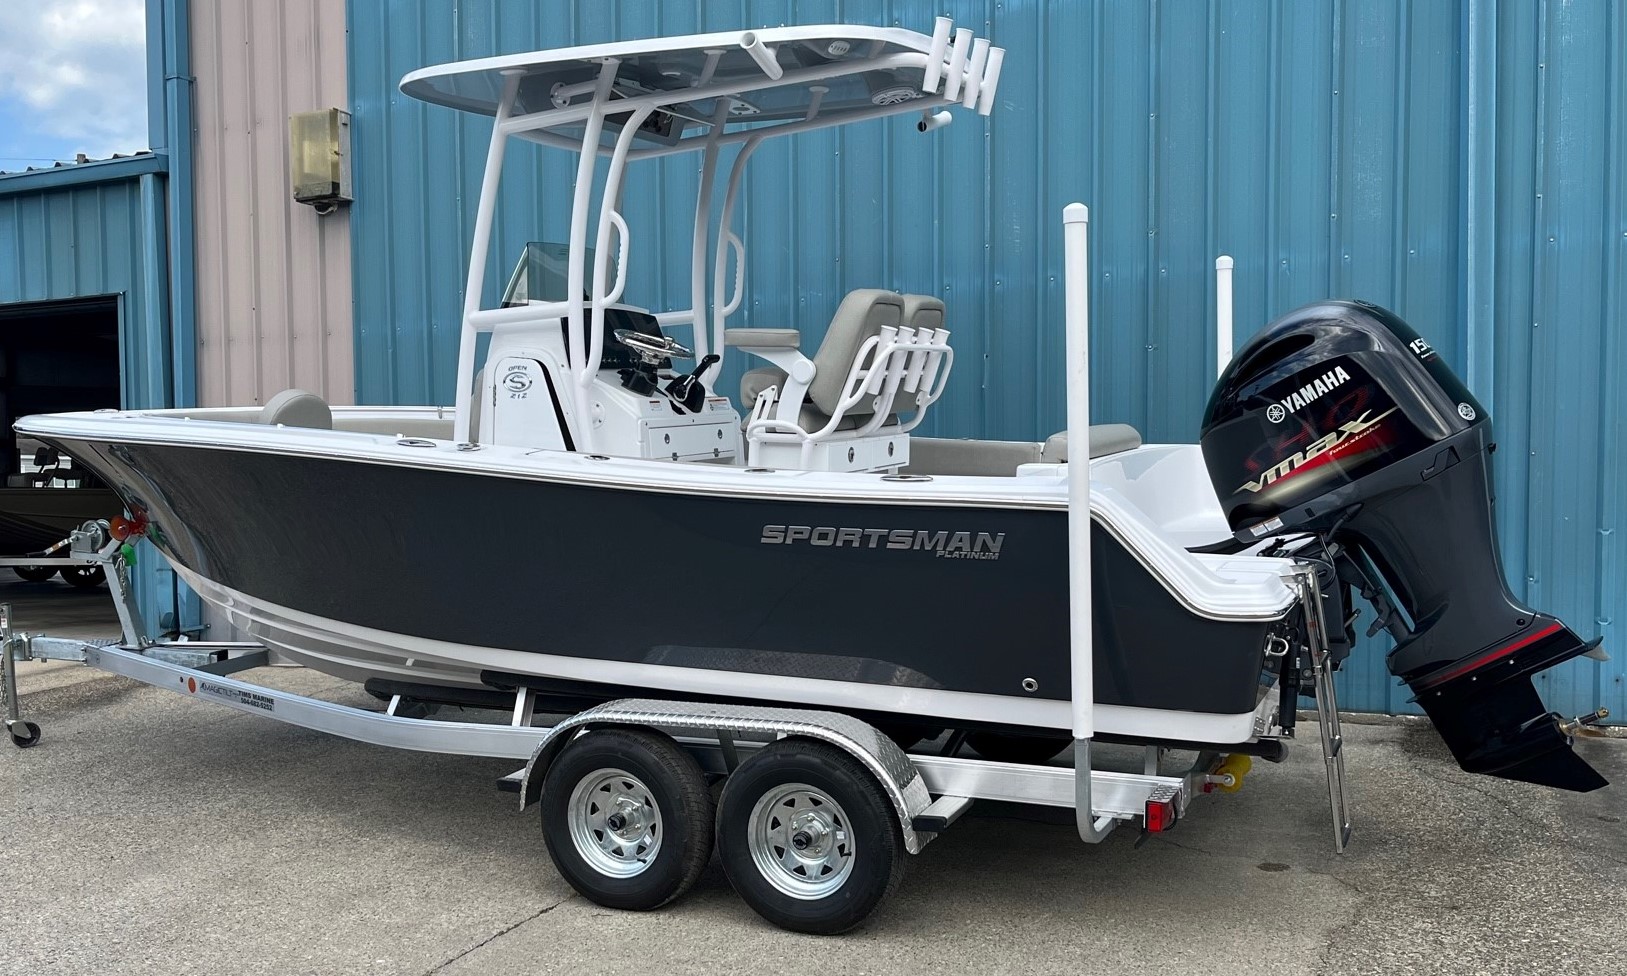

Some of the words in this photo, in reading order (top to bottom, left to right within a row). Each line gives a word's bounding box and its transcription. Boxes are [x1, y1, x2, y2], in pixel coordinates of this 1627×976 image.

[1280, 365, 1351, 414] YAMAHA
[760, 524, 1006, 552] SPORTSMAN
[935, 550, 1000, 560] PLATINUM
[238, 690, 252, 699] TIMS
[252, 694, 274, 705] MARINE
